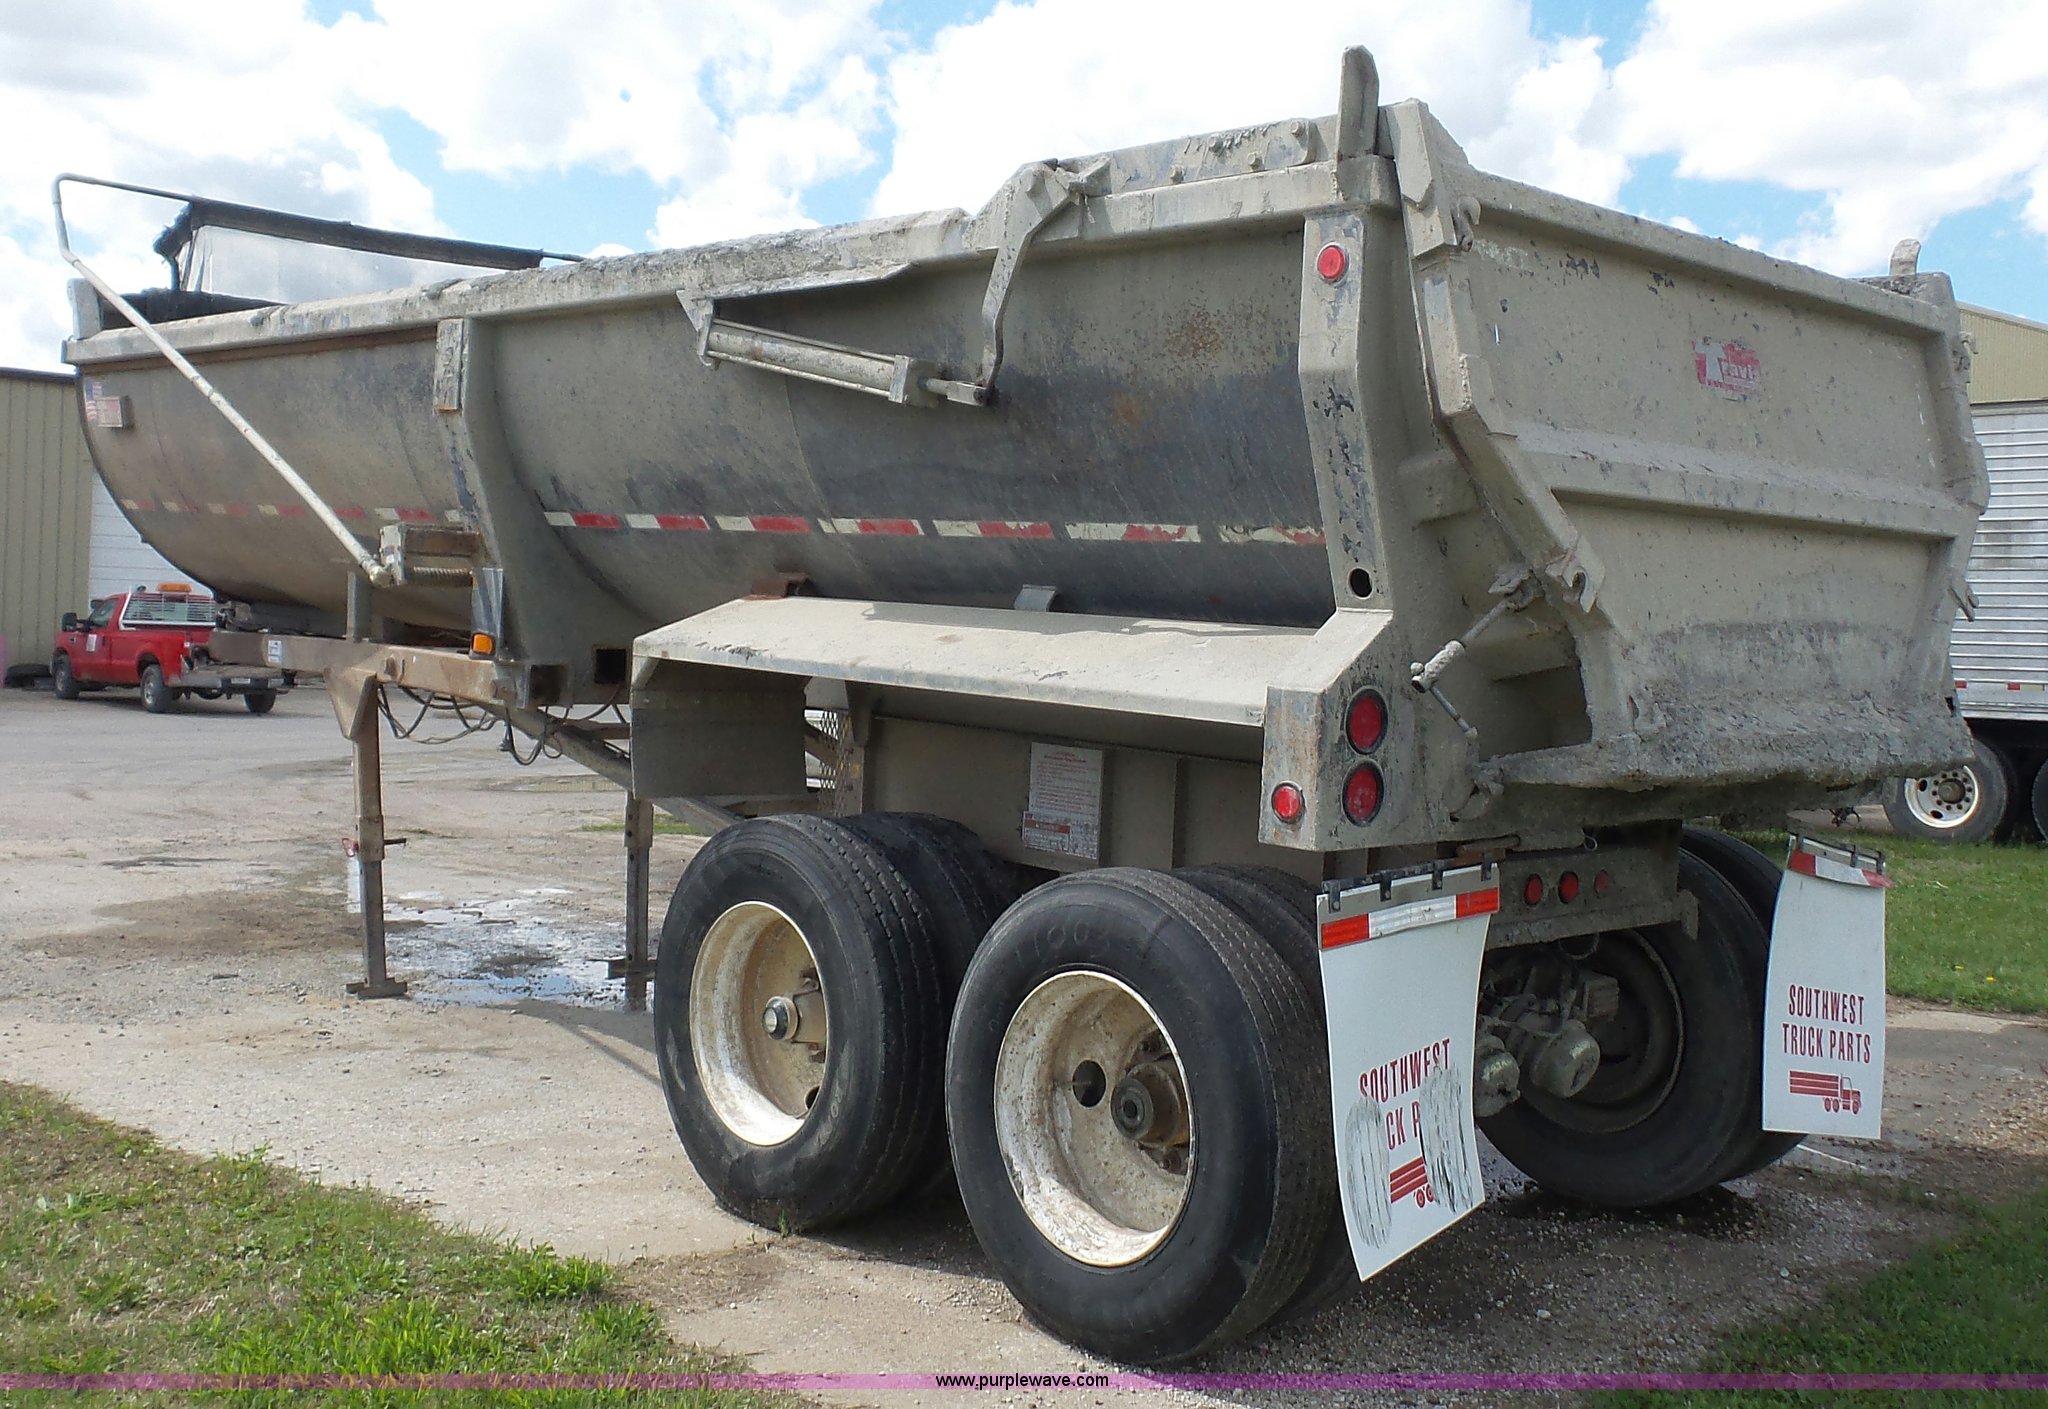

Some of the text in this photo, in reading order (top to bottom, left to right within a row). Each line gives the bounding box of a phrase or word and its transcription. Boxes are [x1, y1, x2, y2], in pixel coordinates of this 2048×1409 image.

[1789, 984, 1864, 1025] SOUTHWEST
[1782, 1023, 1870, 1064] TRUCK PARTS
